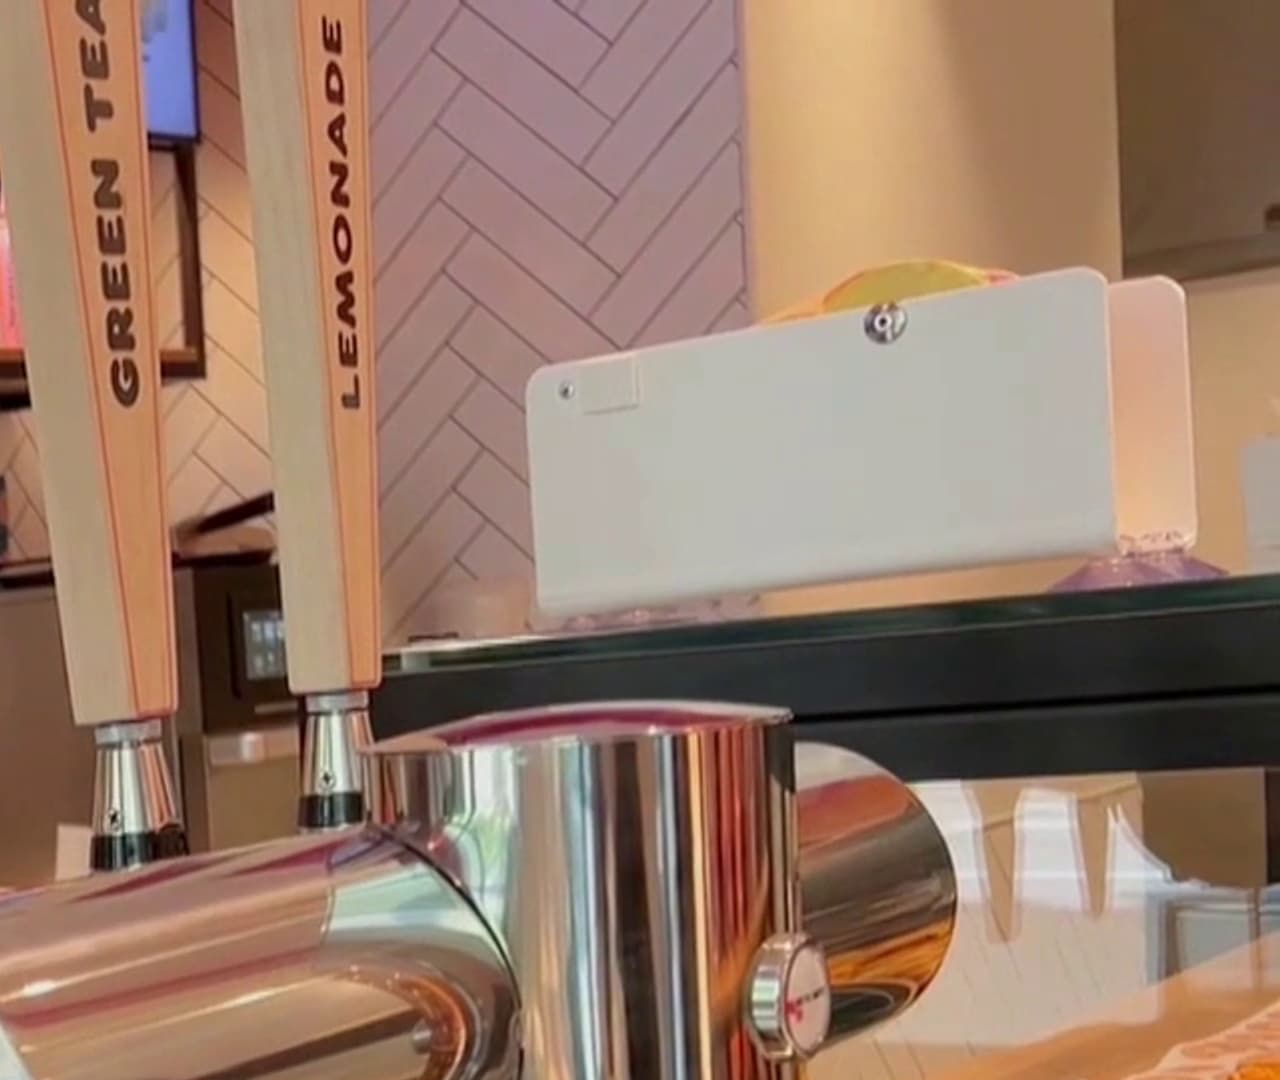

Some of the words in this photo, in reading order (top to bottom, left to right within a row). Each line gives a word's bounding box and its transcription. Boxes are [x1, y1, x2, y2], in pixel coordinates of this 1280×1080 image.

[75, 0, 114, 133] TEA
[91, 159, 140, 408] GREEN
[322, 15, 360, 410] LEMONADE
